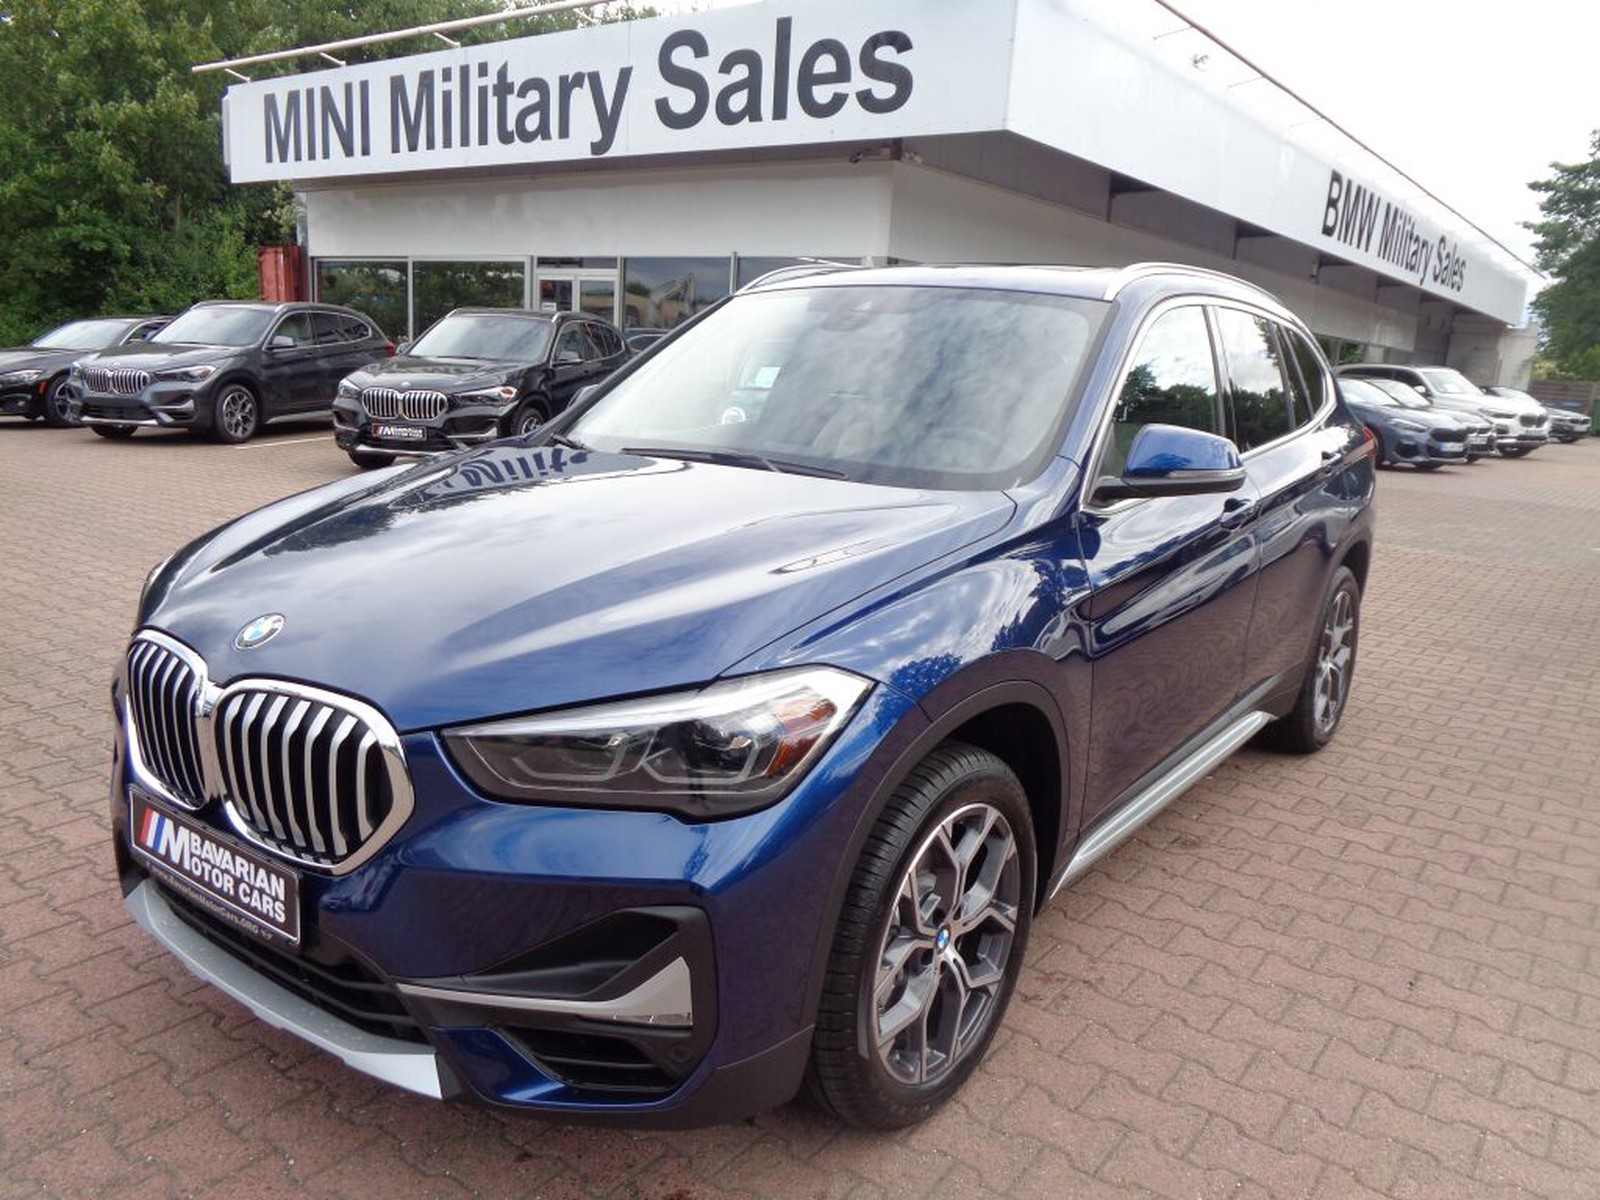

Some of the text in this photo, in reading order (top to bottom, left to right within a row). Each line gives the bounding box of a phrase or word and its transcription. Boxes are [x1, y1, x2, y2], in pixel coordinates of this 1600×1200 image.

[263, 16, 914, 164] MINI Military Sales
[1321, 169, 1468, 292] BMW Military Sales
[190, 831, 286, 902] BAVARIAN
[238, 882, 287, 924] CARS
